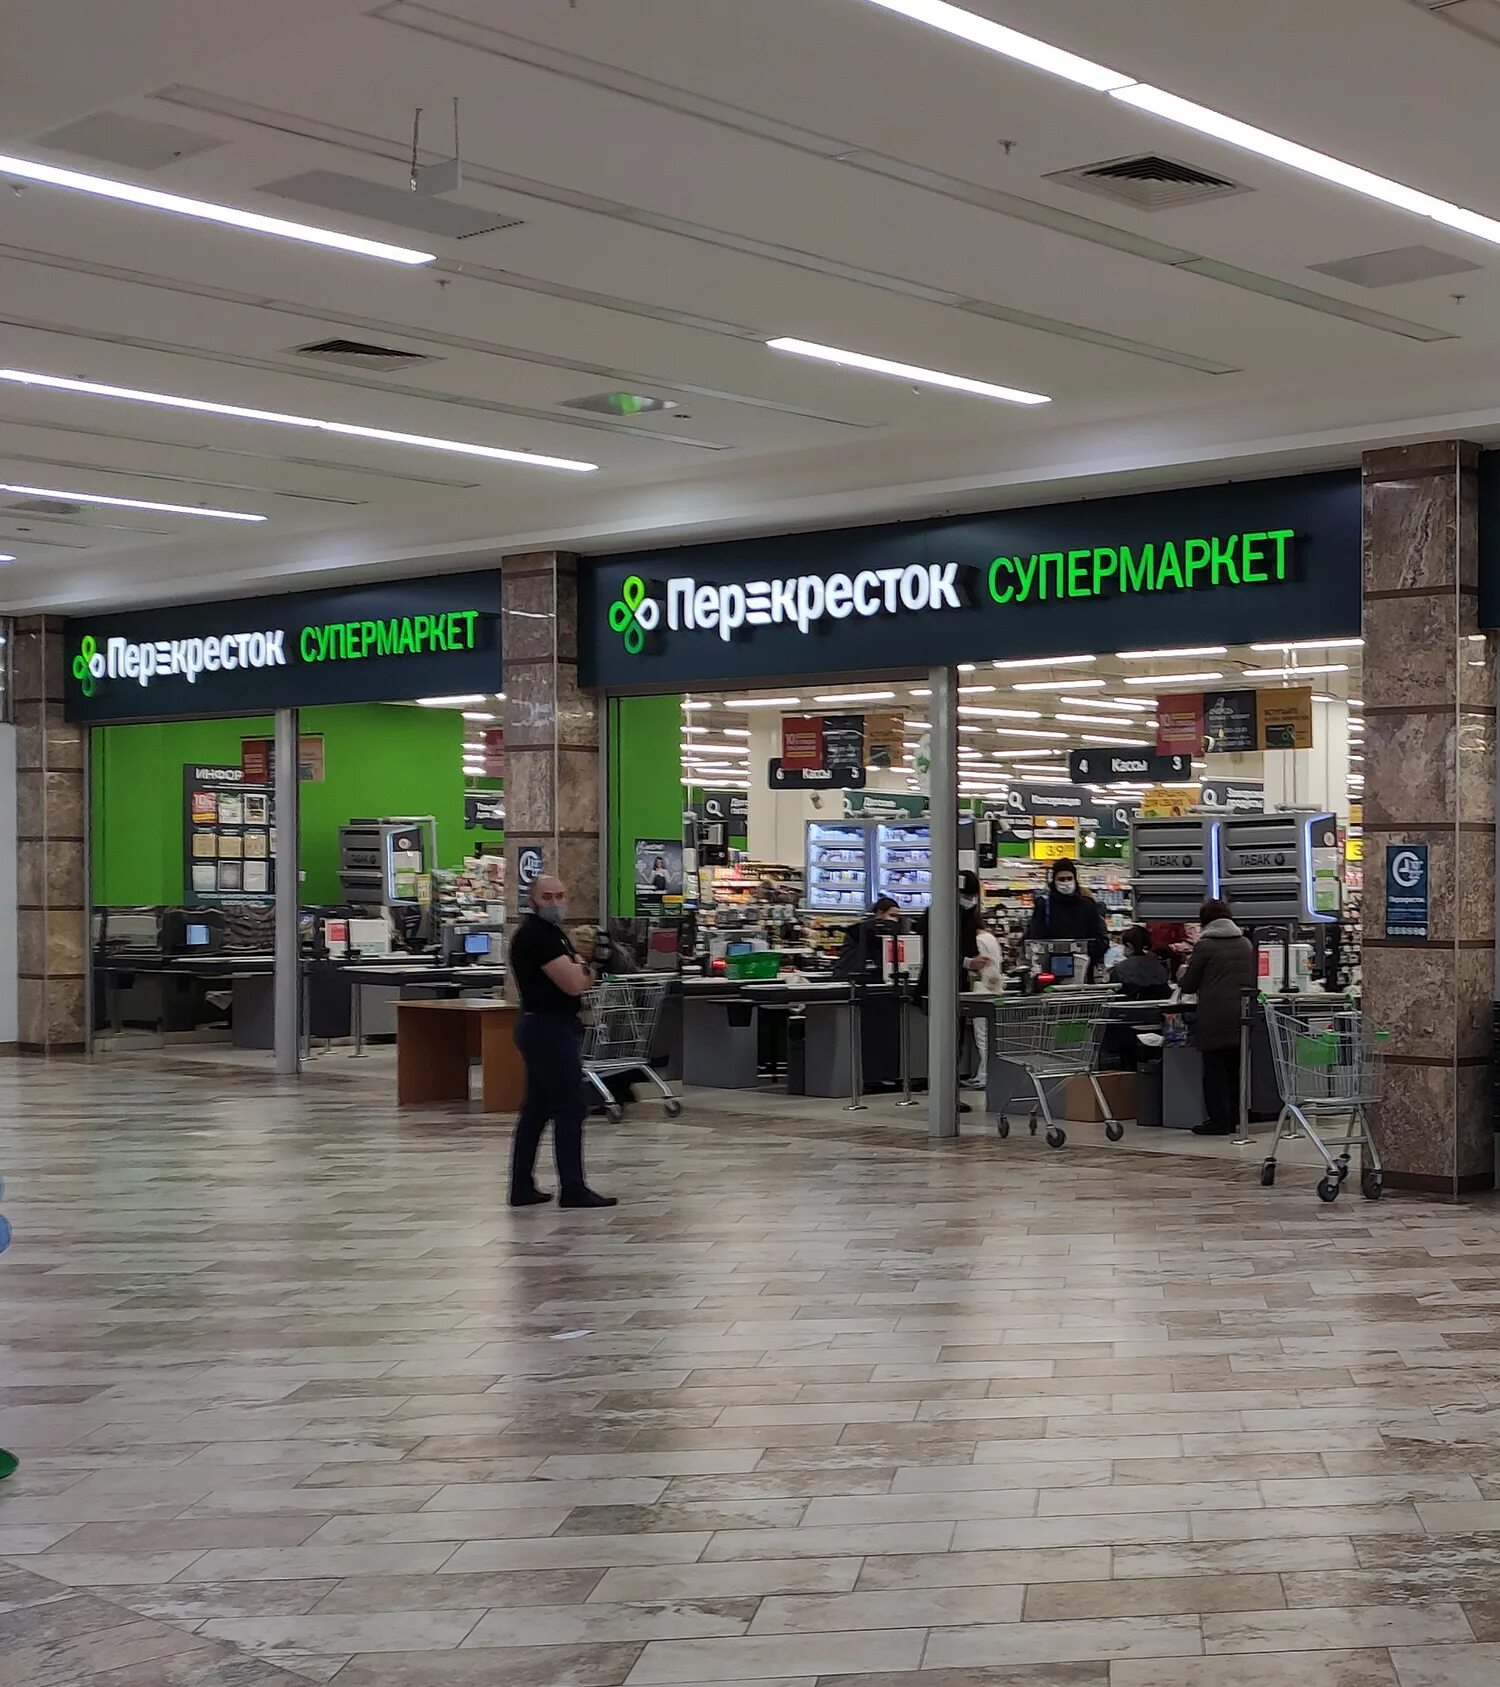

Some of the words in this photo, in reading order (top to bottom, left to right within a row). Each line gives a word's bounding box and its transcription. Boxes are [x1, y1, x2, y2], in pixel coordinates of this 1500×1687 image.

[667, 562, 962, 642] Перекресток
[988, 529, 1295, 604] СУПЕРМАРКЕТ
[107, 629, 287, 687] Перекресток
[300, 610, 479, 662] СУПЕРМАРКЕТ
[1111, 758, 1149, 772] Кассы
[1148, 856, 1179, 867] ТАБАК
[1240, 853, 1271, 865] ТАБАК
